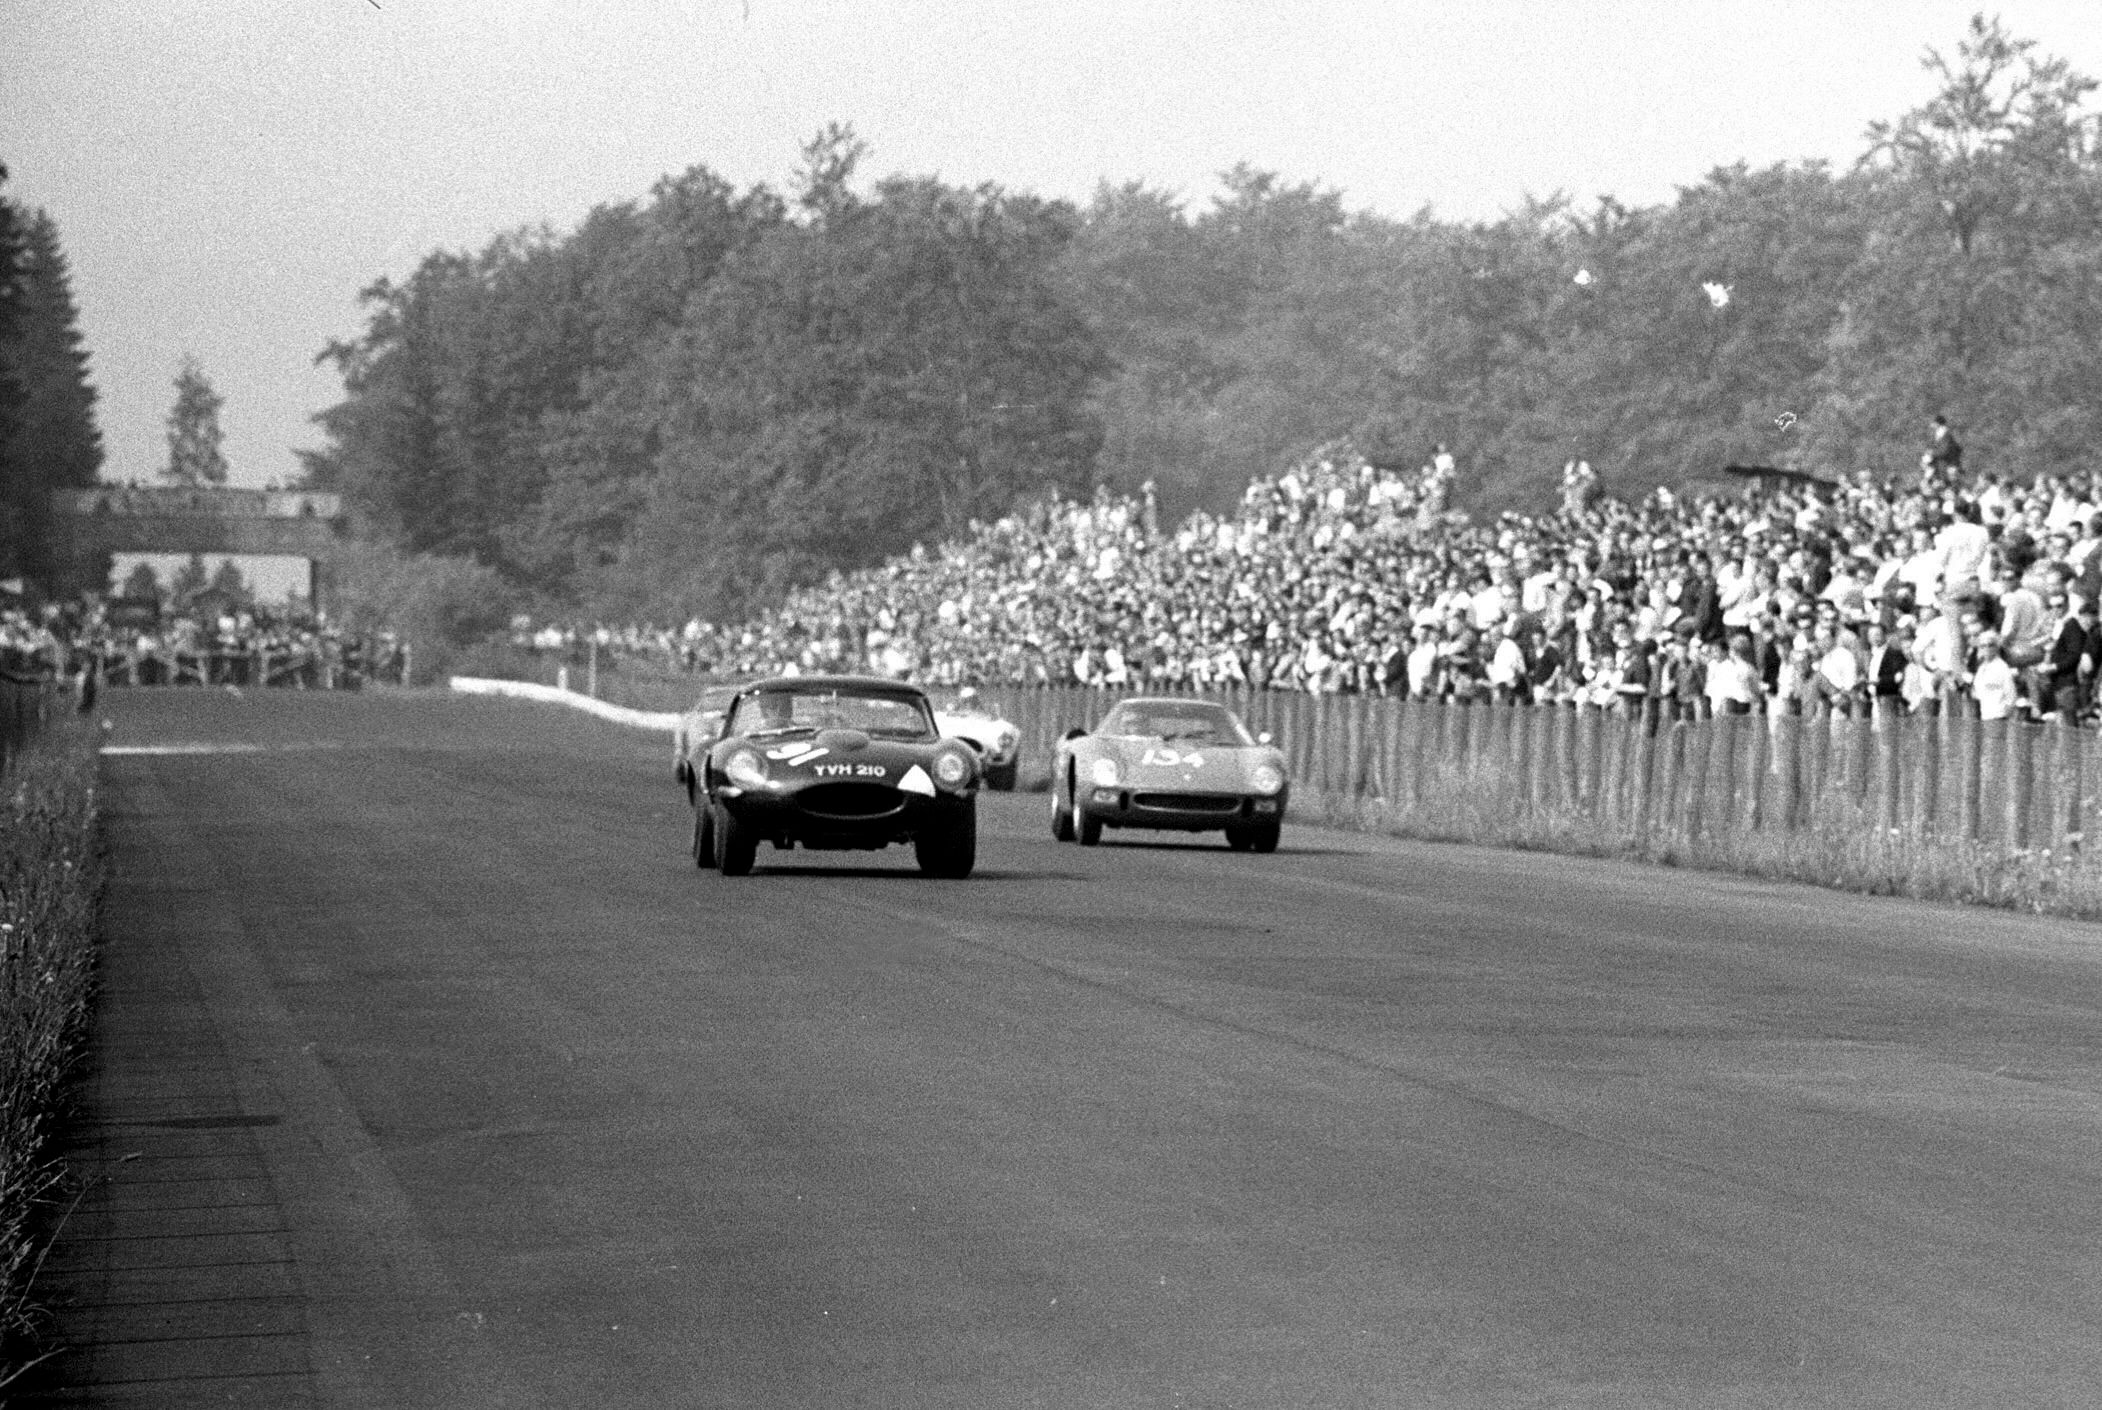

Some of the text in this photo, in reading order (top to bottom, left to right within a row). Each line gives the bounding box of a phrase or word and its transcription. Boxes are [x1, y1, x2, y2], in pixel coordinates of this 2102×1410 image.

[1141, 749, 1204, 768] 134
[814, 764, 886, 777] YVH 210
